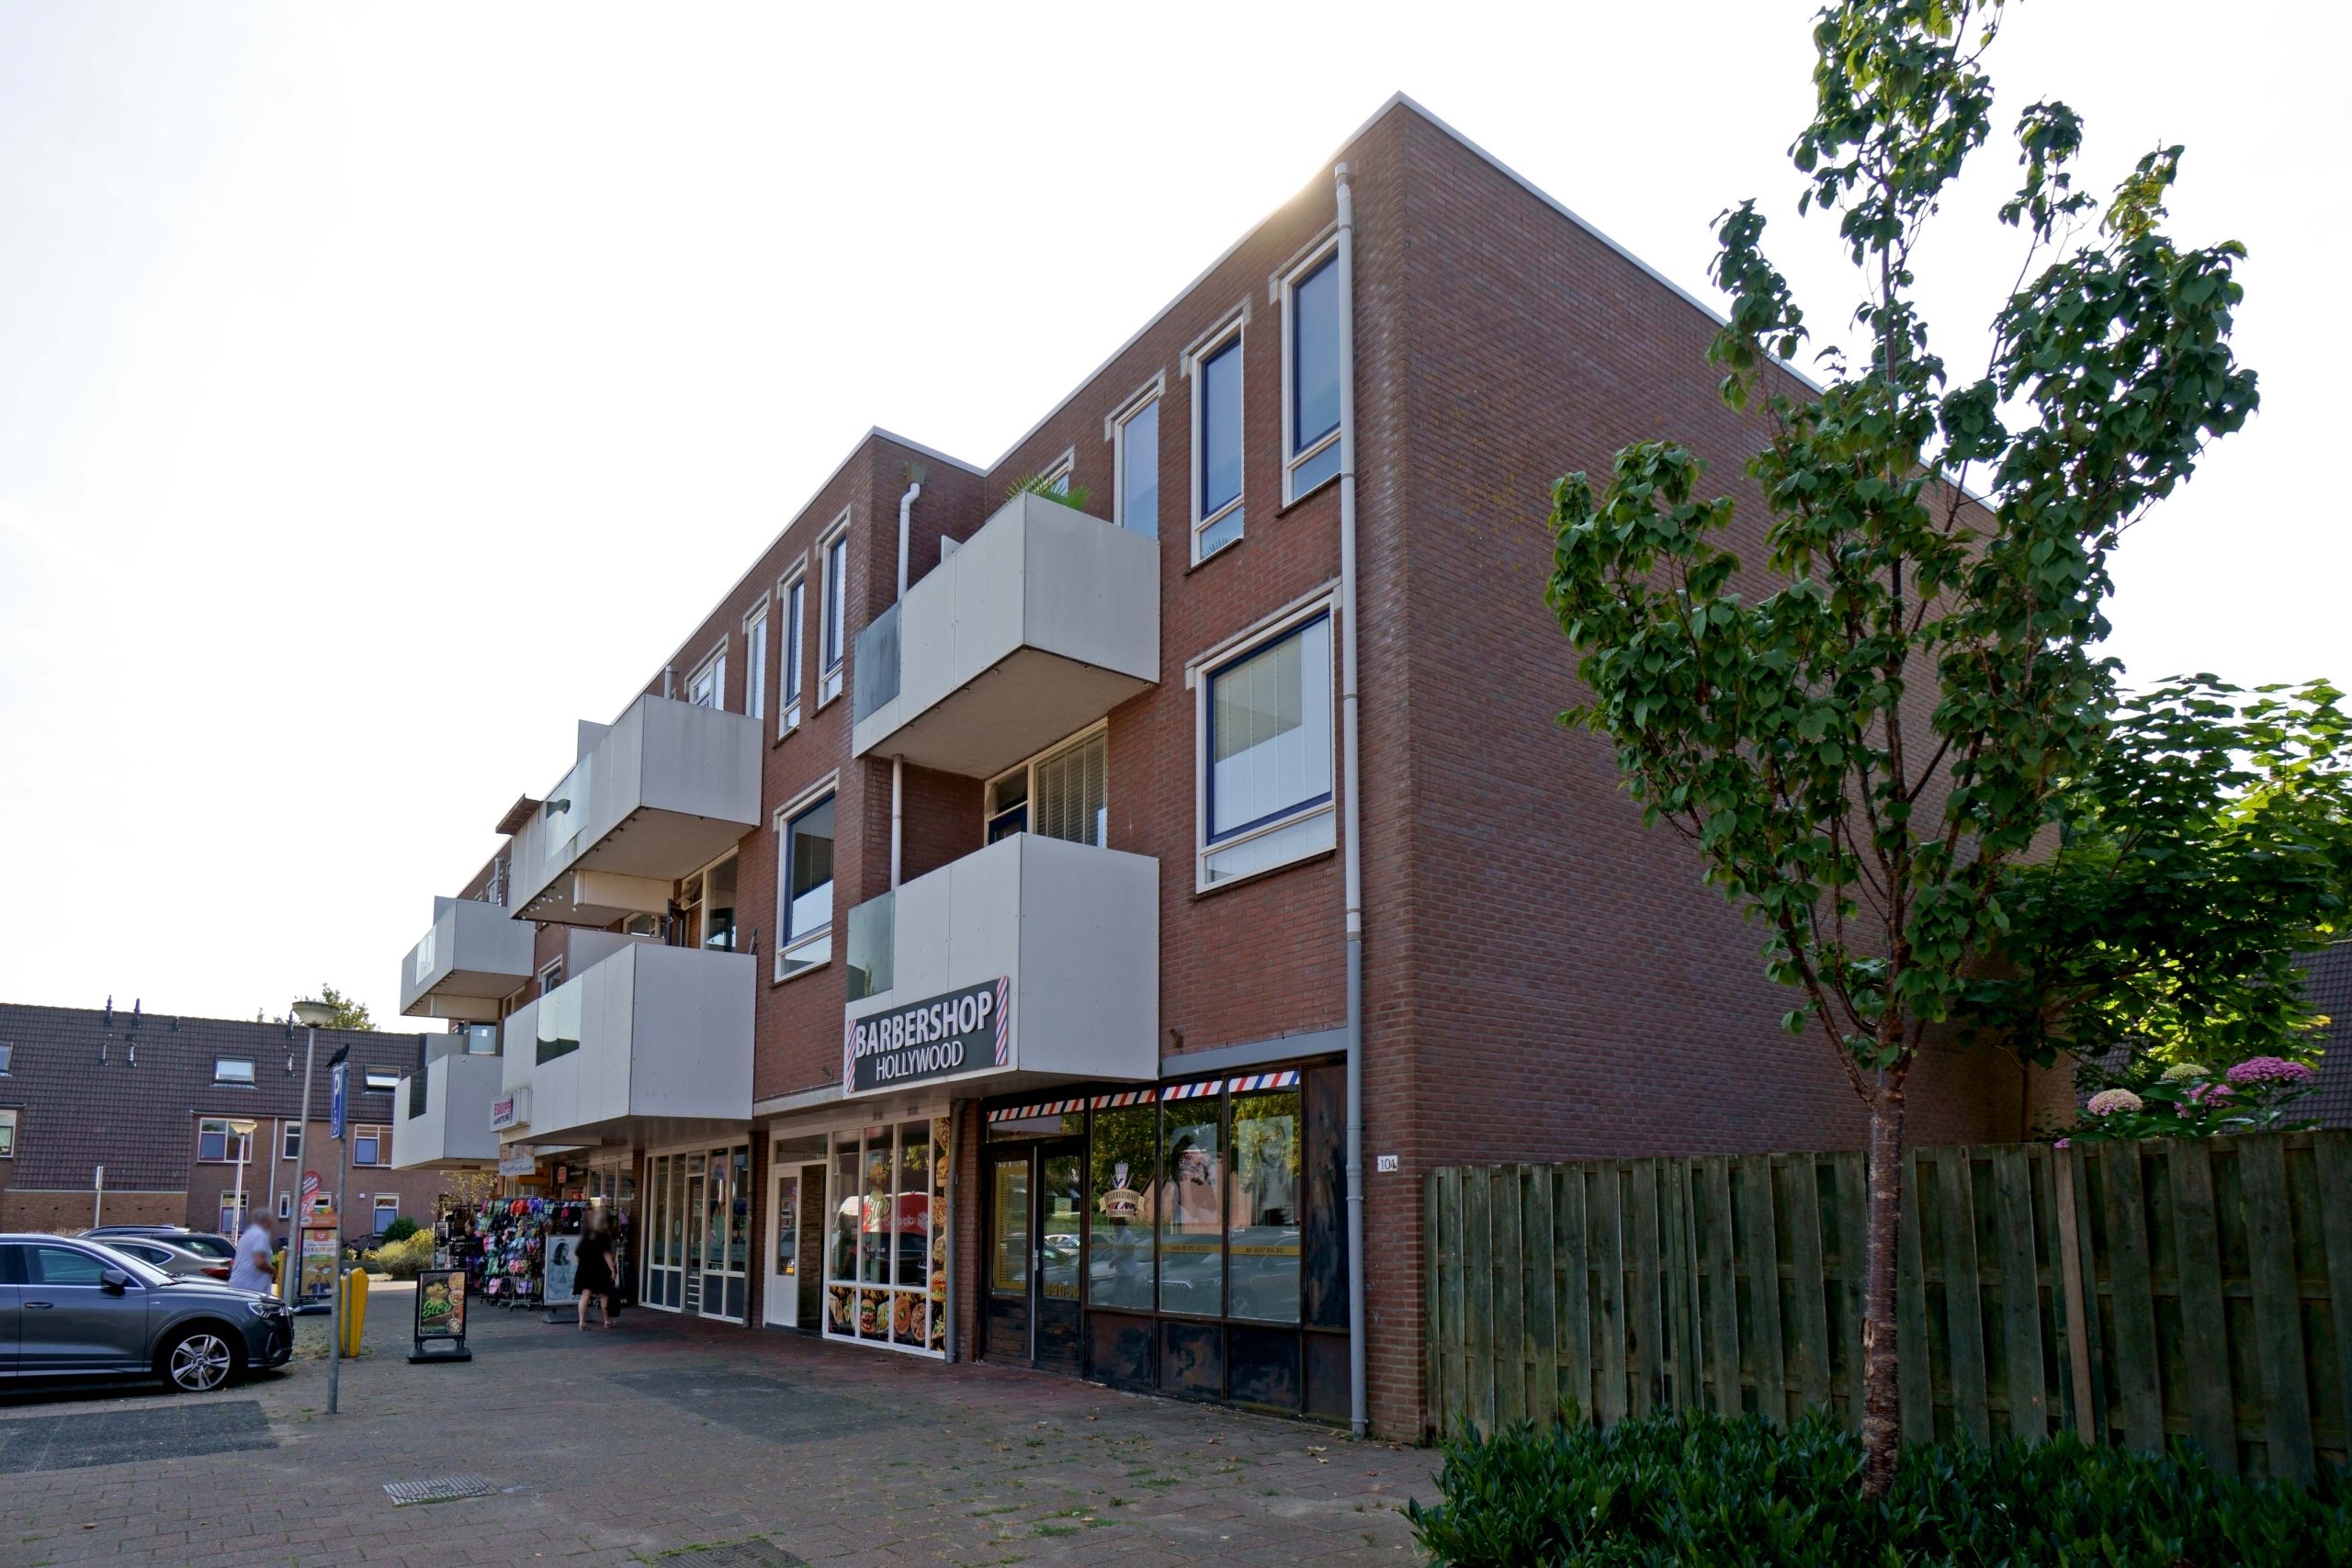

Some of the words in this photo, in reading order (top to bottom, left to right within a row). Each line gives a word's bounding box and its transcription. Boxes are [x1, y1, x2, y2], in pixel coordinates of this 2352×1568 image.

[855, 991, 995, 1058] BARBERSHOP
[876, 1040, 965, 1081] HOLLYWOOD
[334, 1073, 341, 1109] P
[1381, 1158, 1397, 1170] 104
